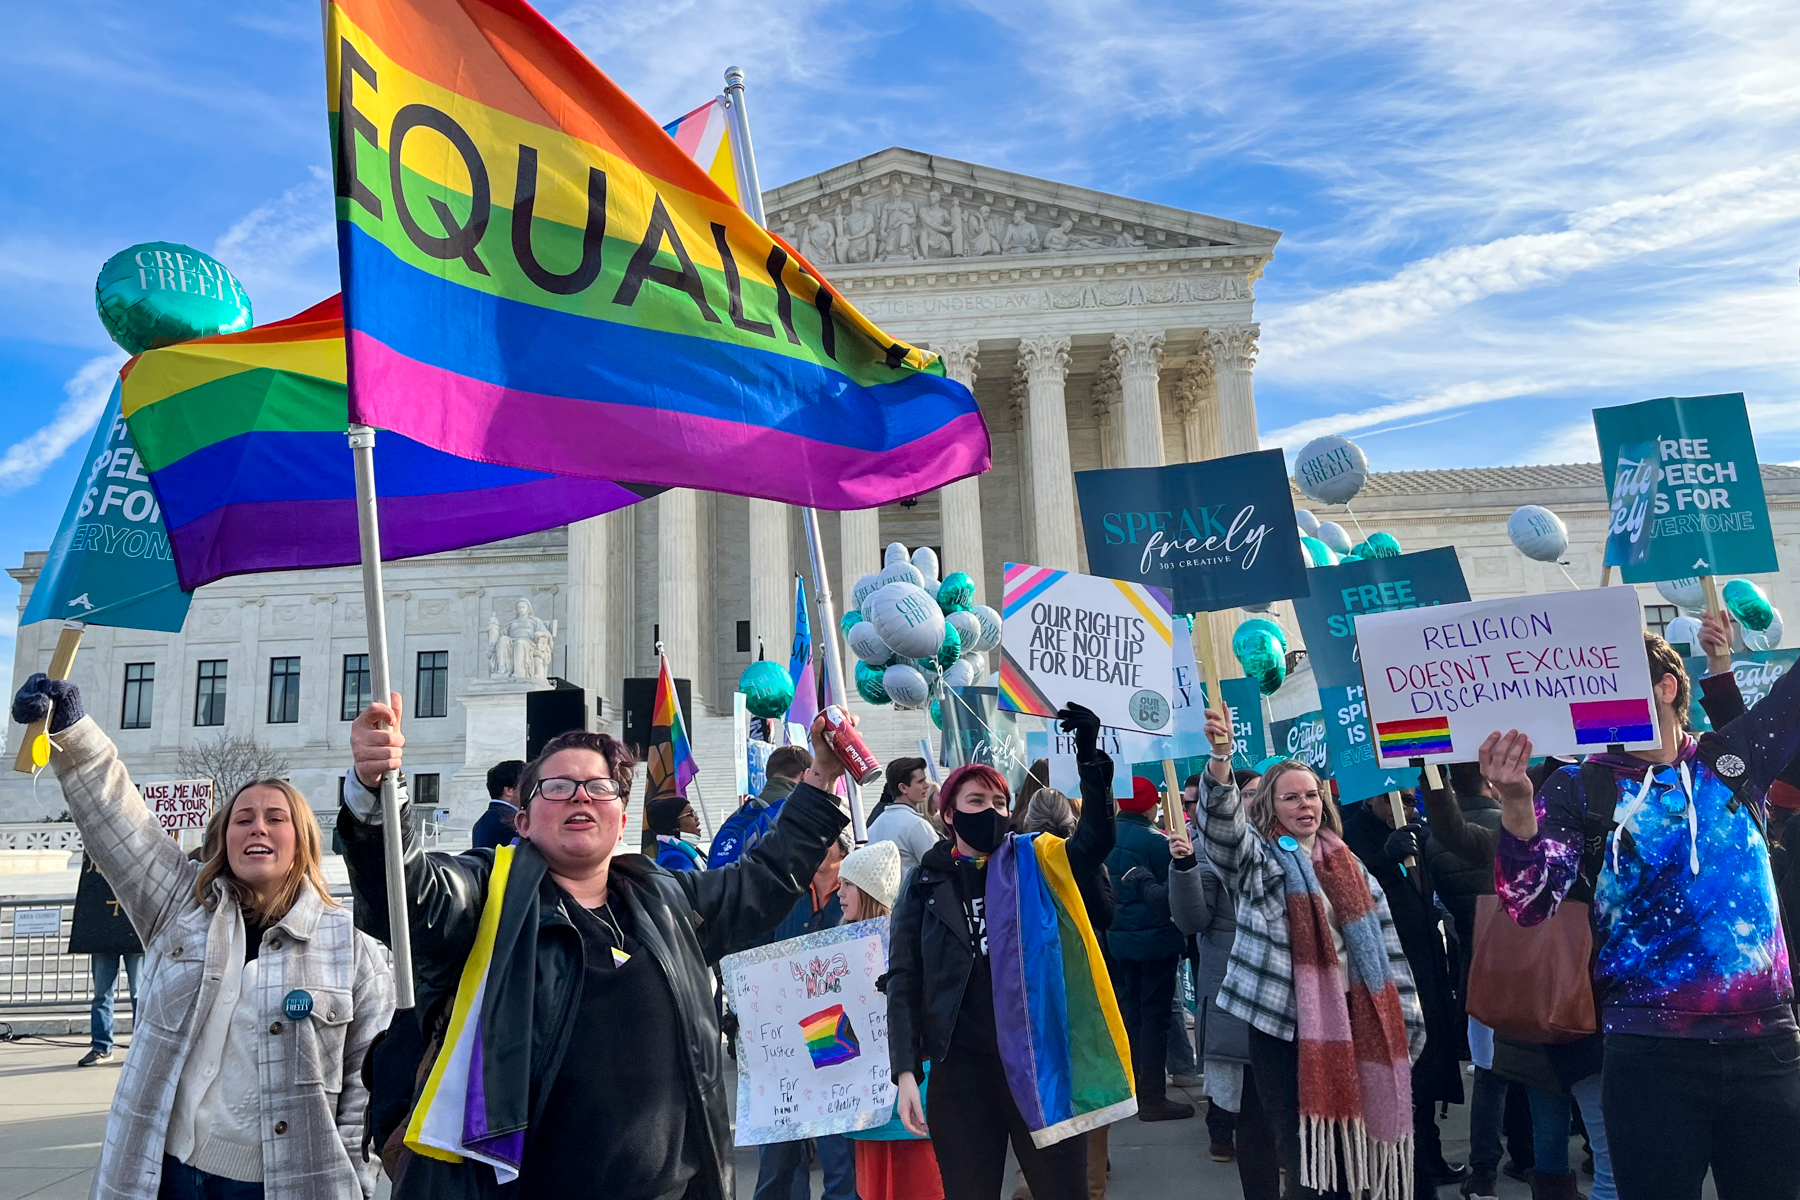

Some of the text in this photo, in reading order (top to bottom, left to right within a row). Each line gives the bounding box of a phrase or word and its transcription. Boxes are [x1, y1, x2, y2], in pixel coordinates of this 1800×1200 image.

[135, 251, 242, 292] CREATE
[138, 268, 245, 309] FREELY
[923, 296, 989, 313] UNDER
[994, 294, 1031, 309] LAW
[1301, 446, 1352, 475] CREATE
[1660, 438, 1711, 461] REE
[87, 447, 149, 485] SPEE
[1305, 458, 1355, 487] FREELY
[1654, 488, 1731, 514] S FOR
[1102, 503, 1227, 545] SPEAK
[1140, 504, 1274, 575] freely
[1159, 555, 1232, 570] 303 CREATIVE
[1341, 579, 1417, 611] FREE
[1031, 602, 1145, 643] OUR RIGHTS
[1422, 611, 1552, 650] RELIGION
[1029, 625, 1068, 652] ARE
[1073, 632, 1111, 659] NOT
[1114, 639, 1143, 663] UP
[1029, 649, 1067, 676] FOR
[1072, 655, 1144, 688] DEBATE
[1386, 646, 1621, 693] DOESN'T EXCUSE
[1140, 696, 1160, 707] OUR
[1410, 672, 1618, 714] DISCRIMINATION
[1287, 720, 1326, 754] Create
[1347, 724, 1366, 745] IS
[145, 783, 211, 799] USE ME NOT
[155, 799, 208, 812] FOR YOUR
[760, 1022, 784, 1041] For
[761, 1044, 795, 1062] Justice
[780, 1077, 799, 1091] For
[831, 1084, 853, 1099] For
